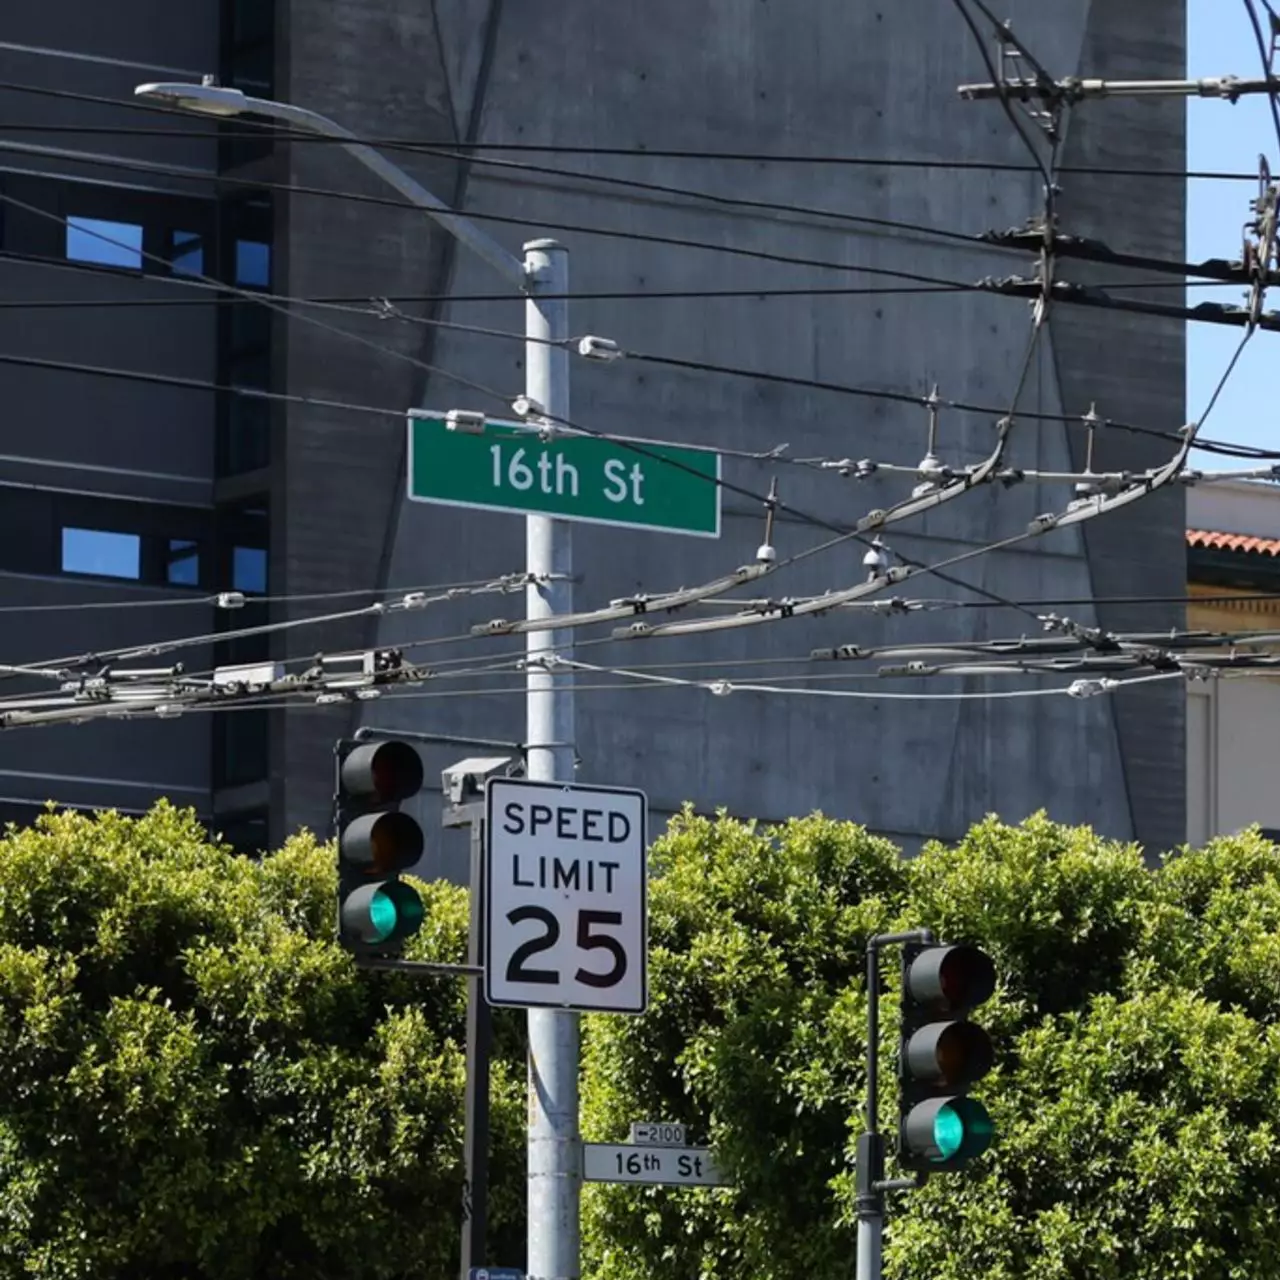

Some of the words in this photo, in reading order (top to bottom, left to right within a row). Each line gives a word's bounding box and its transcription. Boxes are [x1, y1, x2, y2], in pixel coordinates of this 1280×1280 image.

[490, 444, 579, 496] 16th
[603, 459, 645, 505] St
[503, 802, 631, 843] SPEED
[512, 854, 620, 894] LIMIT
[505, 904, 628, 989] 25
[649, 1127, 683, 1142] 2100
[615, 1152, 661, 1175] 16th
[677, 1155, 703, 1178] St
